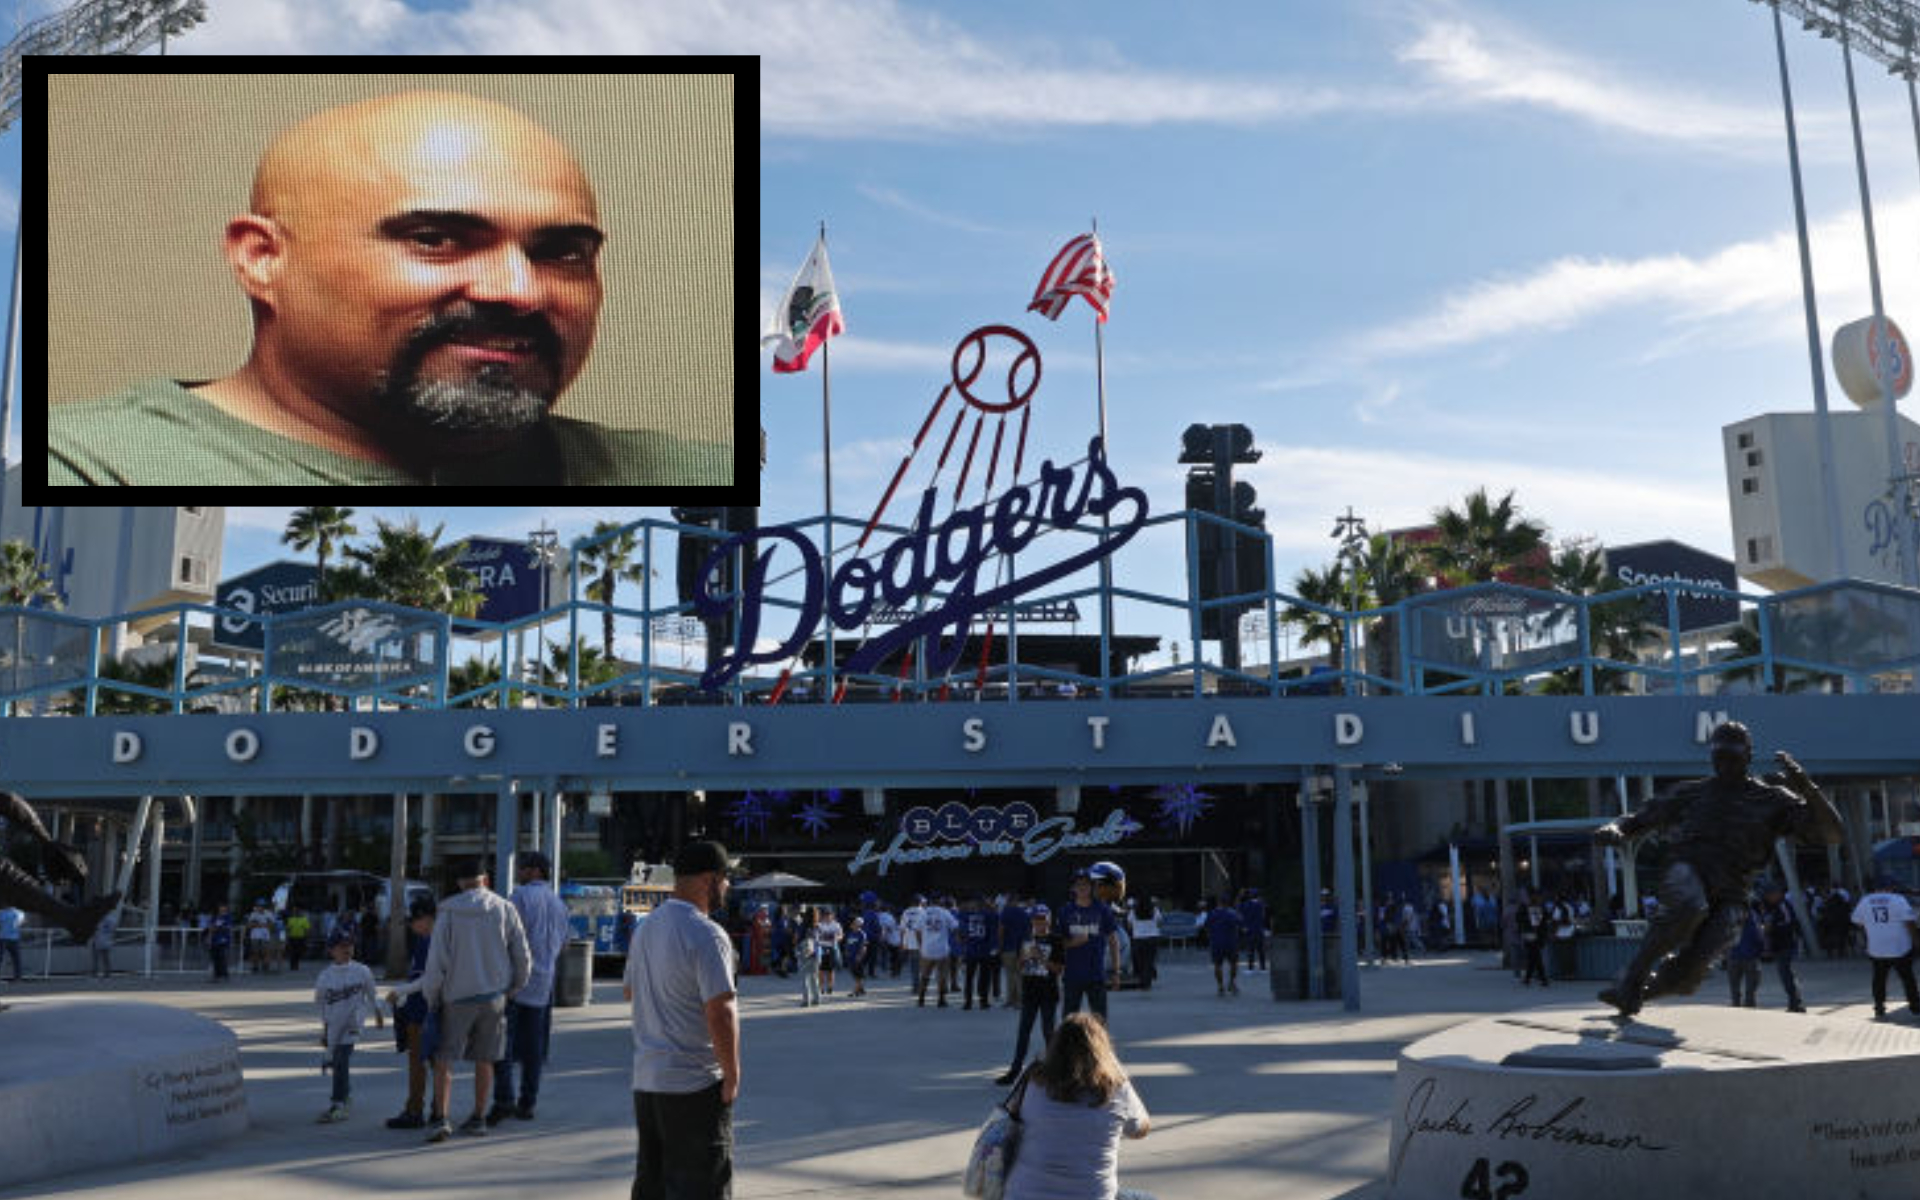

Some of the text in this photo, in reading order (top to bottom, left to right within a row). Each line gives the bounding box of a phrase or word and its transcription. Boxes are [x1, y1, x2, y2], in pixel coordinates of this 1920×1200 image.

[695, 435, 1149, 691] Dodgers
[112, 710, 1730, 764] DODGER STADIUM
[912, 812, 1029, 834] BLUE
[1393, 1077, 1668, 1187] Jackie Robinson
[1460, 1158, 1530, 1200] 42
